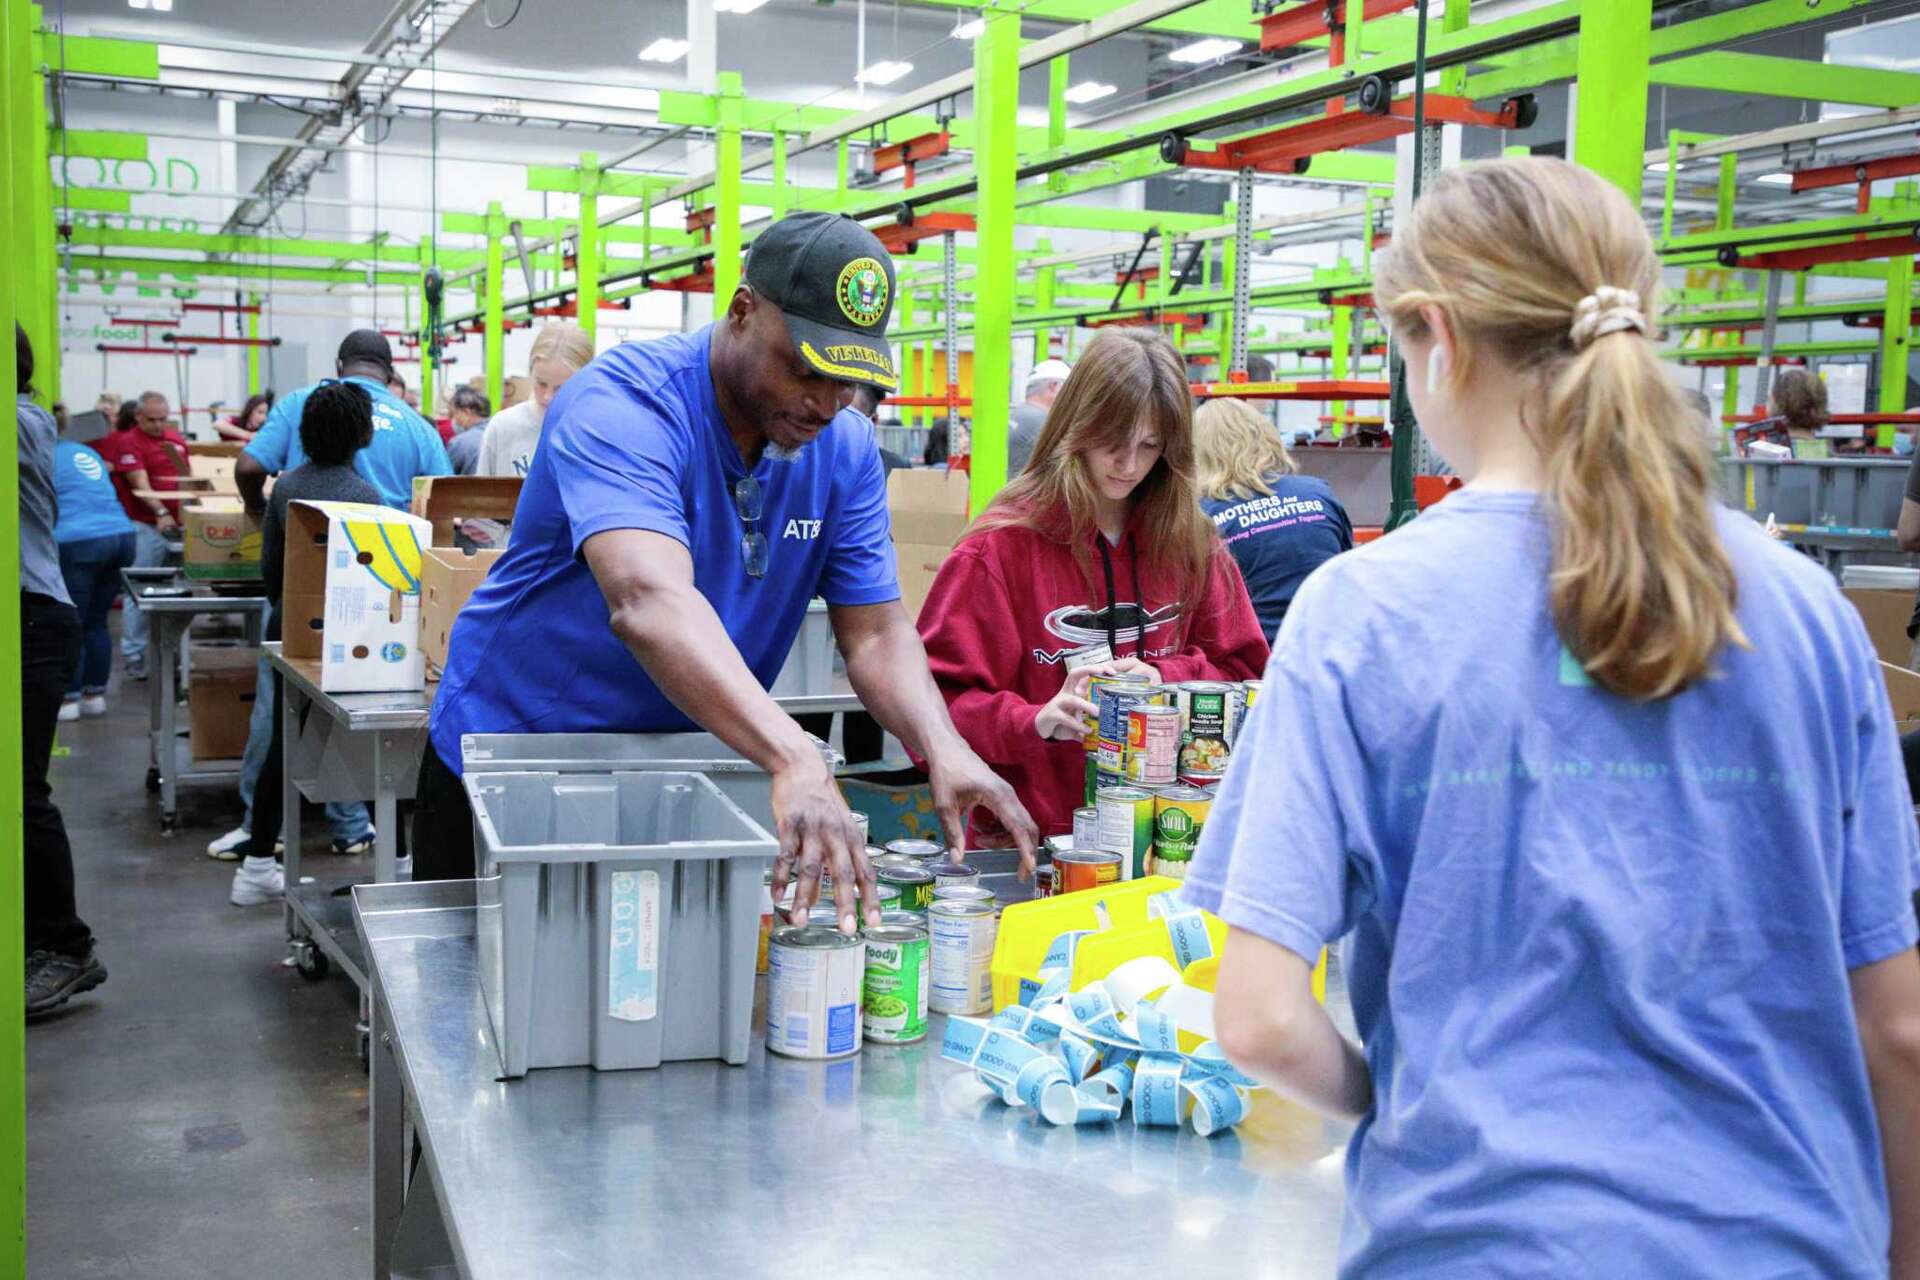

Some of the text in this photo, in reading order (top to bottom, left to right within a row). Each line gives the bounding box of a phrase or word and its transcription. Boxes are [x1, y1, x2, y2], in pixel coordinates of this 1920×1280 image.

[1213, 496, 1280, 526] MOTHERS
[1238, 500, 1323, 528] DAUGHTERS
[783, 519, 823, 540] AT&
